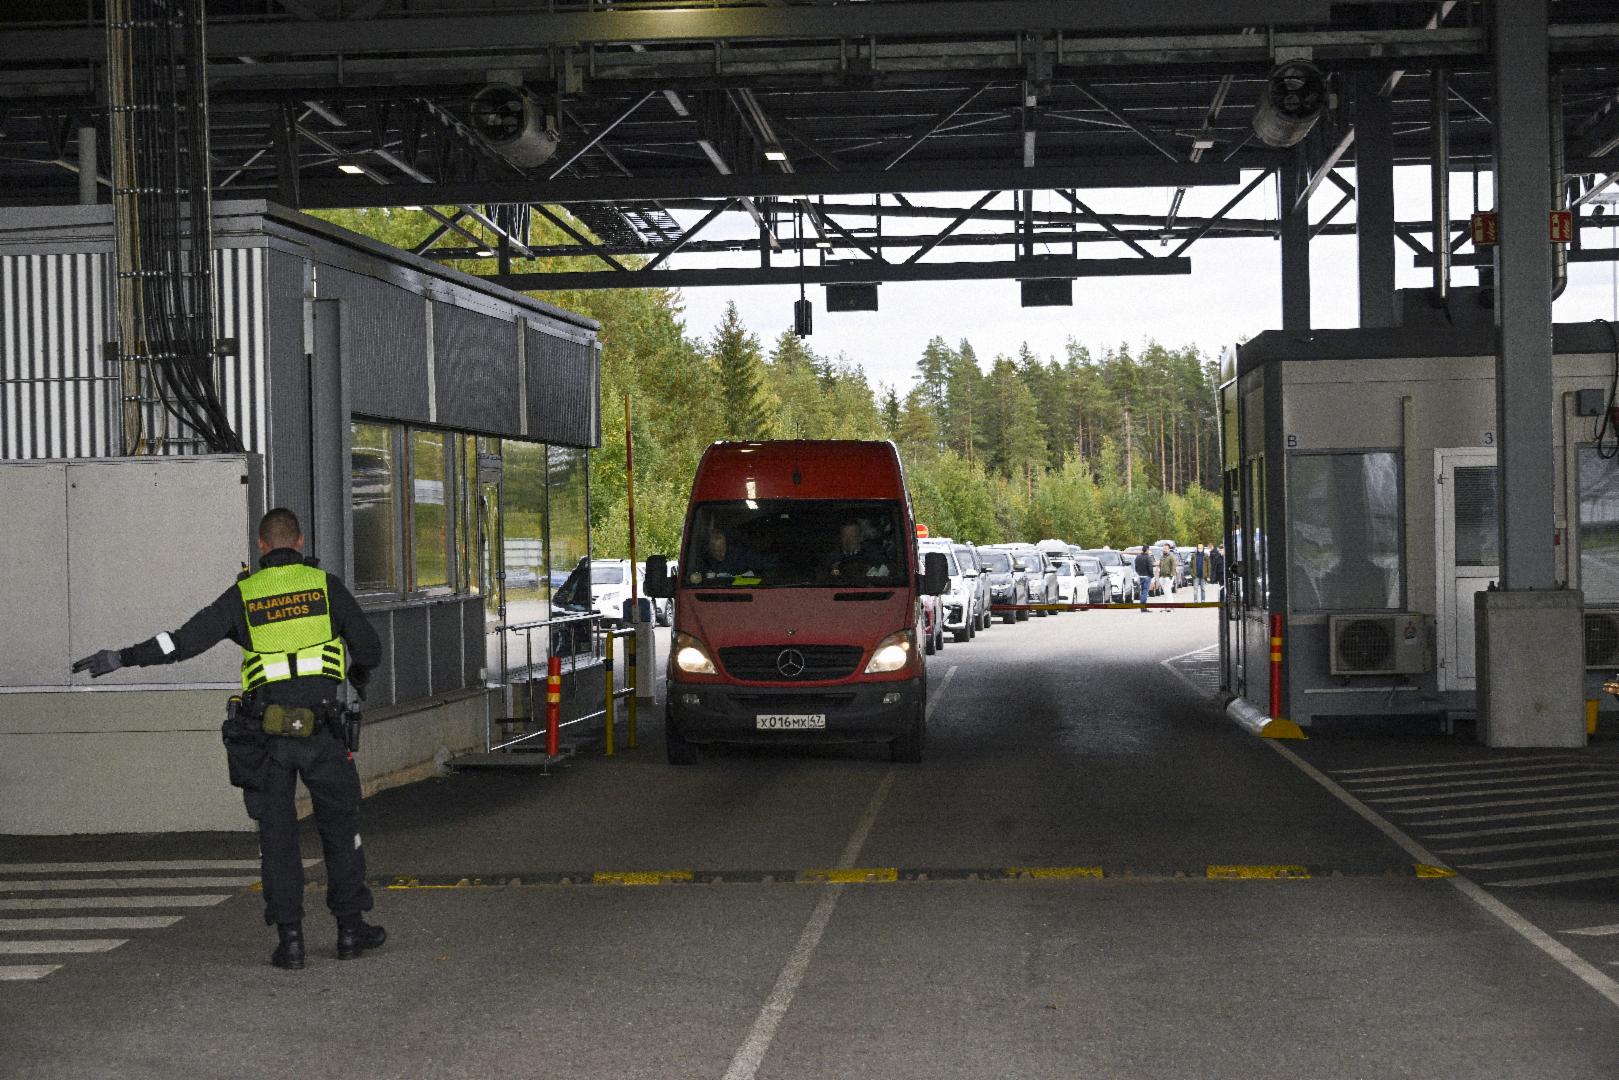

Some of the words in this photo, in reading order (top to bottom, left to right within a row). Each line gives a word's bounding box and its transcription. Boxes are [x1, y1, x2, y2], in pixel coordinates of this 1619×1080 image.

[1288, 435, 1297, 447] B
[1485, 432, 1493, 444] 3
[248, 591, 325, 613] RAJAVARTIO-
[267, 604, 310, 620] LAITOS
